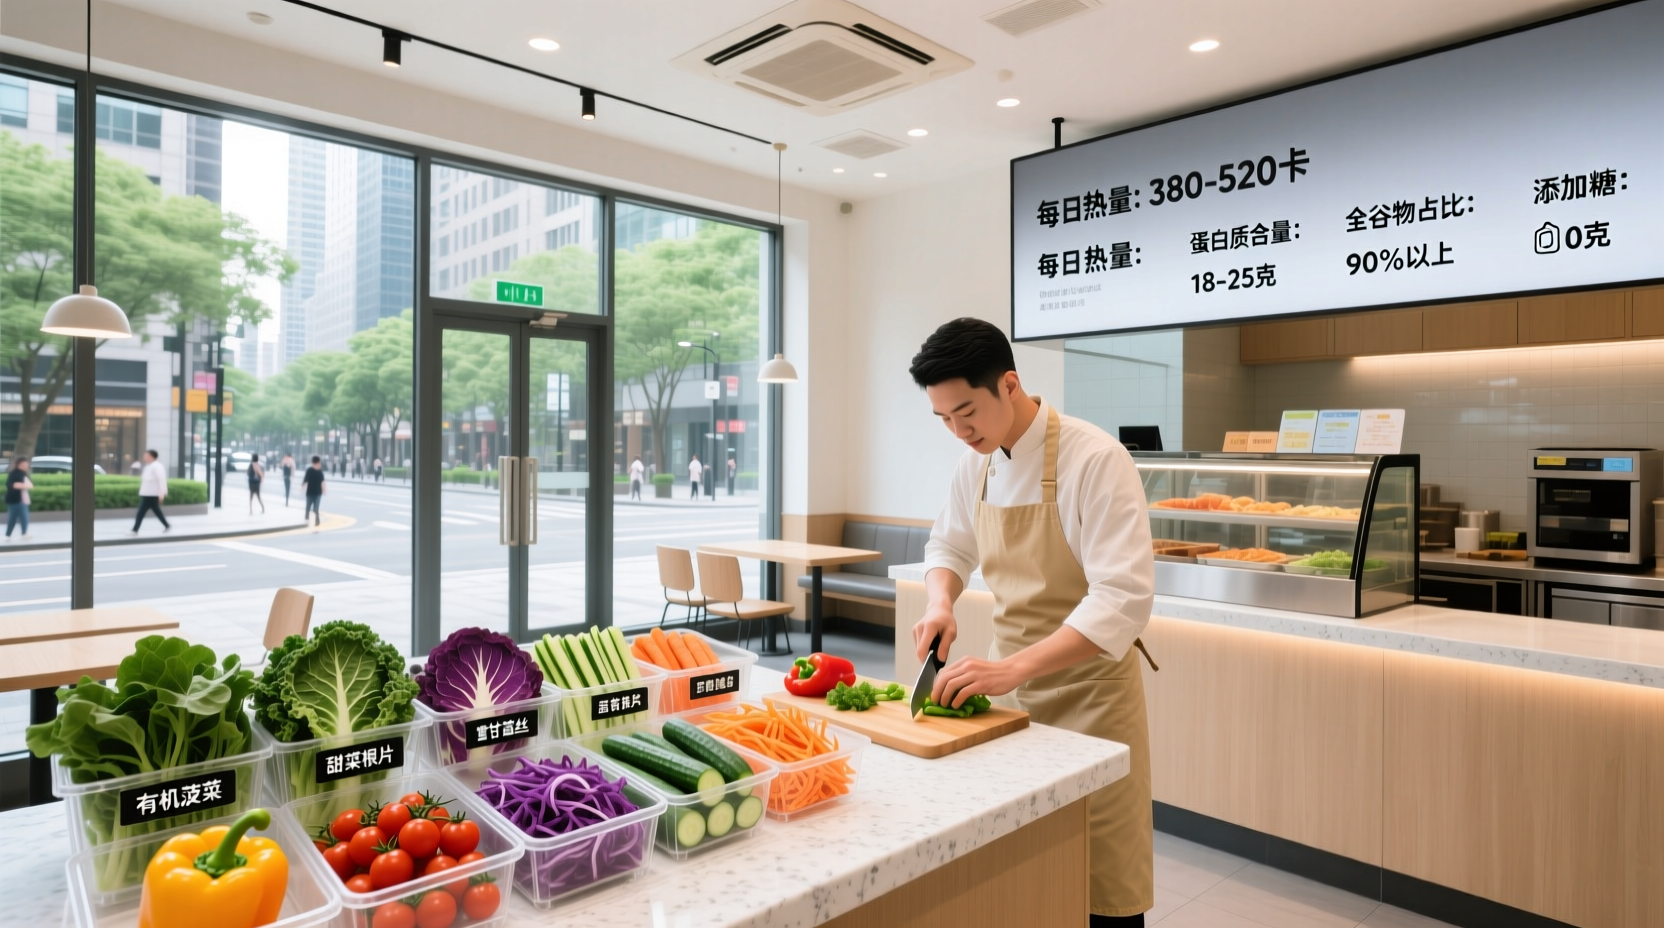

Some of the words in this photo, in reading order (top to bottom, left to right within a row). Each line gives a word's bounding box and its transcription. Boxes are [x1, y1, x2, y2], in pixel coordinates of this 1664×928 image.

[1149, 147, 1309, 205] 380-520卡
[1534, 168, 1627, 204] 添加糖:
[1346, 193, 1474, 232] 全谷物占比:
[1037, 242, 1141, 278] 每日热量:
[1346, 241, 1454, 275] 90%以上
[1191, 263, 1276, 293] 18-25克
[325, 744, 394, 775] 甜菜根片
[136, 778, 222, 816] 有机菠菜
